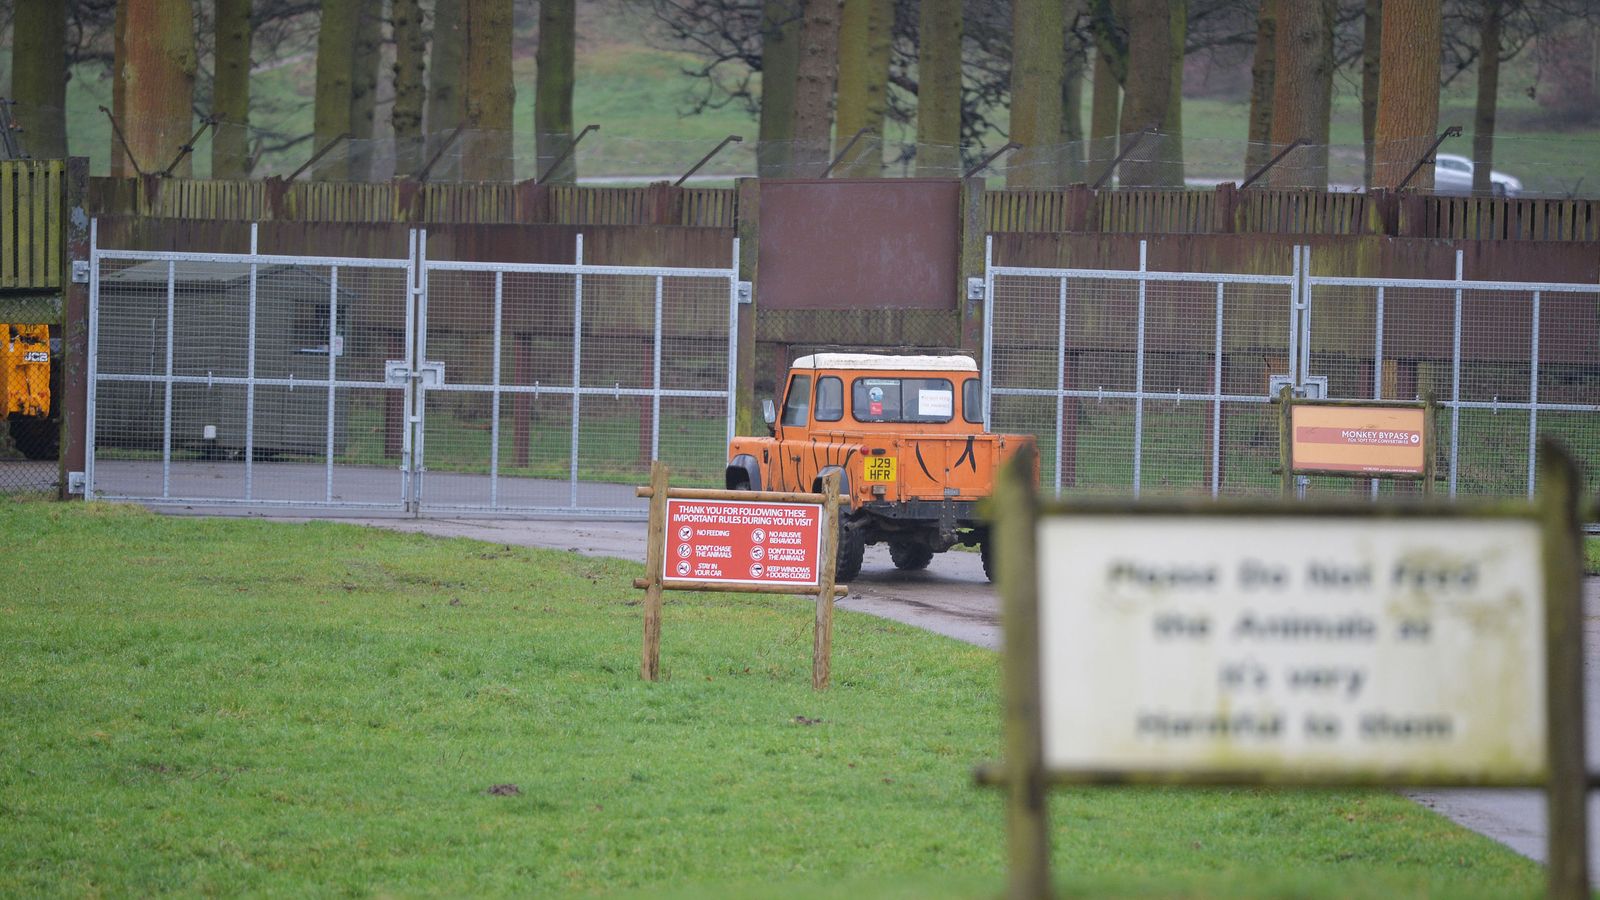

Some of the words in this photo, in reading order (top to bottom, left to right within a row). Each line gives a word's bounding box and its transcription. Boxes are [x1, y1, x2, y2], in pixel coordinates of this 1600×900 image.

[24, 352, 48, 362] JCB
[1341, 430, 1378, 439] MONKEY
[1379, 431, 1409, 440] BYPASS
[870, 458, 891, 468] J29
[870, 469, 890, 480] HFR
[678, 505, 705, 514] THANK
[705, 506, 722, 515] YOU
[723, 507, 738, 515] FOR
[739, 507, 783, 517] FOLLOWING
[784, 509, 807, 518] THESE
[673, 513, 718, 523] IMPORTANT
[718, 515, 741, 524] RULES
[742, 516, 772, 525] DURING
[773, 517, 794, 526] YOUR
[795, 518, 813, 526] VISIT
[1107, 557, 1220, 588] Please
[1237, 559, 1288, 588] Do
[1305, 558, 1374, 588] Not
[1393, 558, 1480, 588] Feed
[1154, 610, 1210, 642] the
[1233, 610, 1378, 642] Animals
[1285, 667, 1367, 698] very
[1137, 710, 1283, 739] Harmful
[1304, 712, 1341, 740] to
[1357, 710, 1453, 739] them
